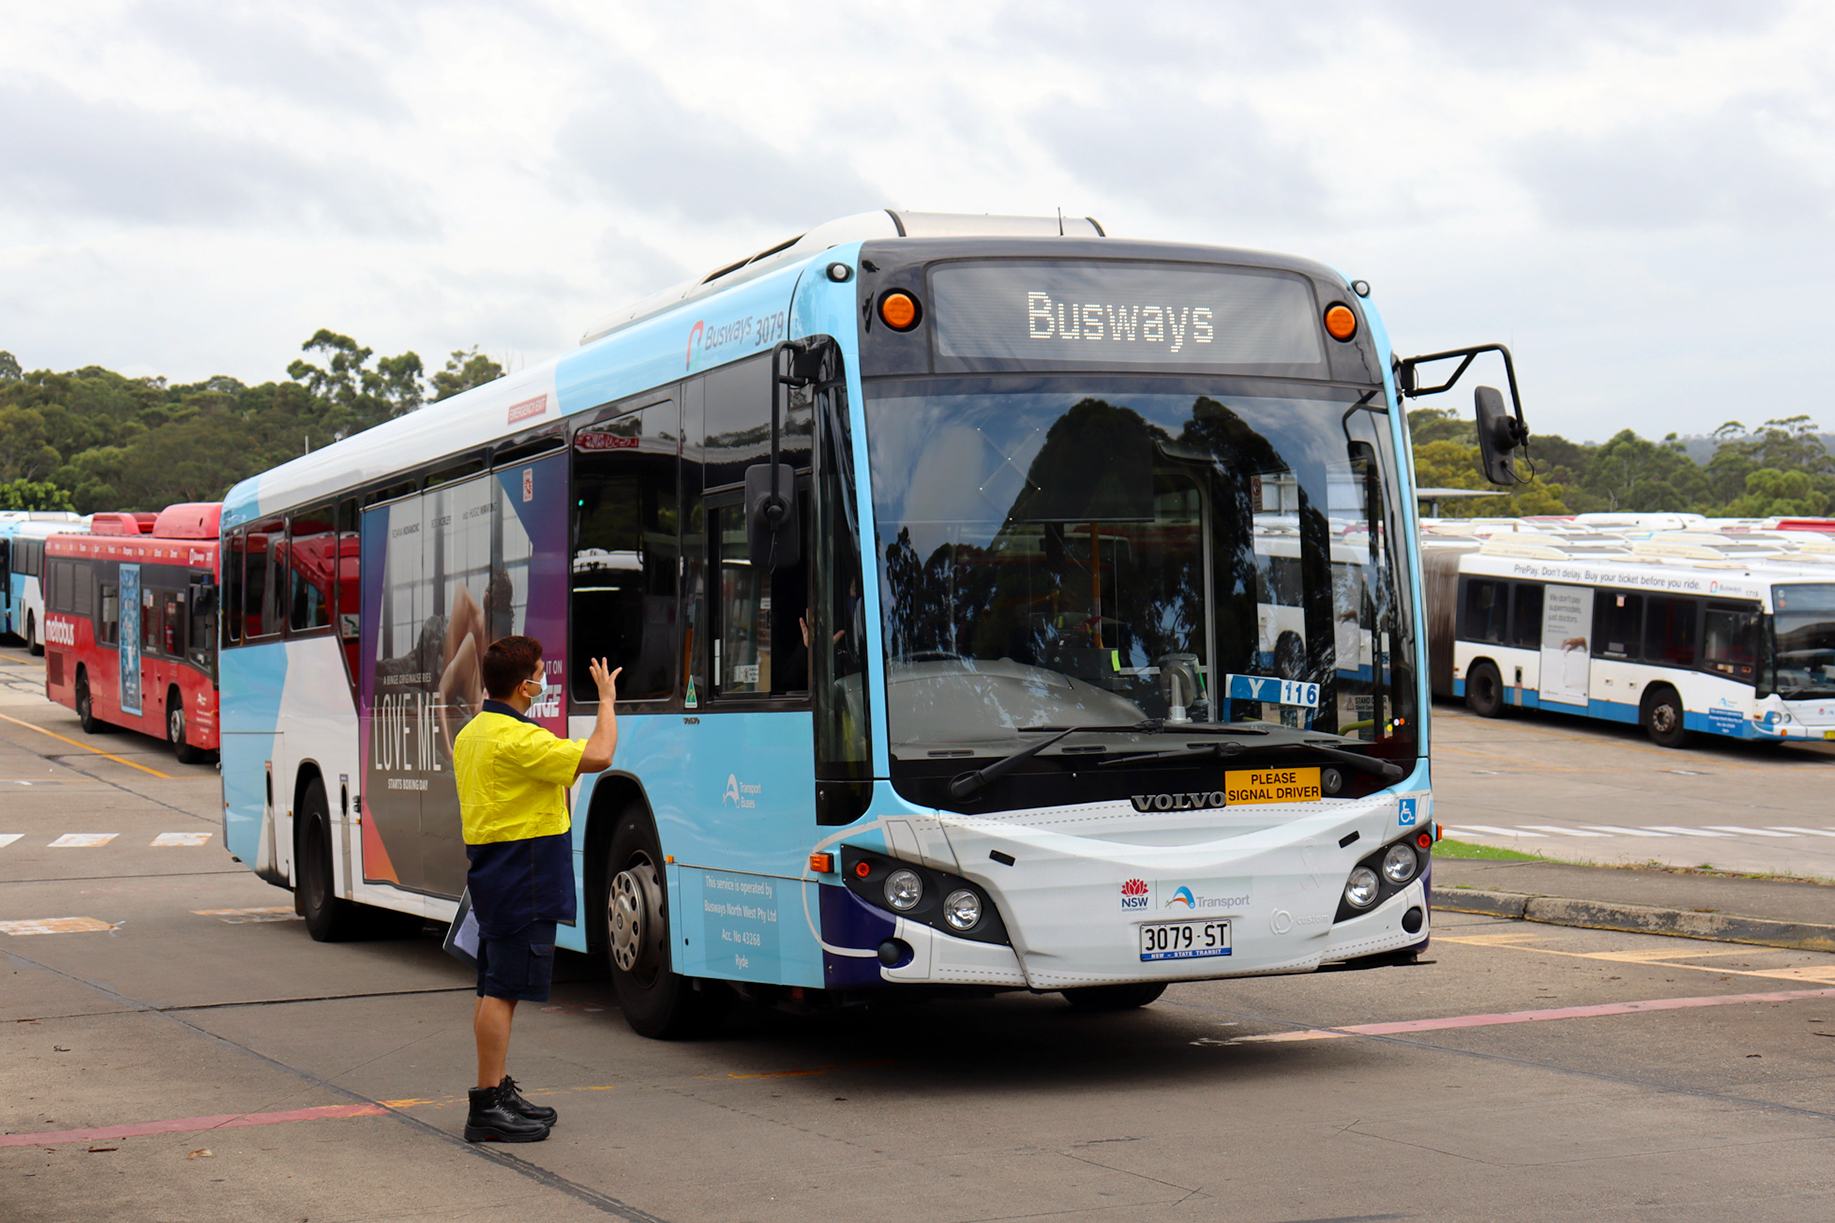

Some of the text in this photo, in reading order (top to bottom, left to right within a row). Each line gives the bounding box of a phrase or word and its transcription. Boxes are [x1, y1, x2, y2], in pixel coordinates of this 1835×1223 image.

[705, 311, 784, 351] Busways 3079
[1028, 291, 1213, 353] Busways
[510, 397, 546, 421] EMERGENCY EXIT
[1514, 564, 1702, 590] PrePay. Don't delay. Buy your ticket before you ride.
[46, 615, 75, 646] metrobus
[553, 660, 563, 675] ON
[1247, 678, 1317, 705] Y 116
[374, 692, 441, 771] LOVE ME
[388, 778, 402, 789] STARTS
[419, 779, 428, 791] DAY
[1251, 772, 1296, 785] PLEASE
[739, 782, 761, 796] Transport
[1229, 786, 1319, 801] SIGNAL DRIVER
[741, 797, 756, 809] Buses
[1131, 791, 1226, 811] VOLVO
[705, 875, 773, 899] This service is operated by
[1121, 897, 1149, 908] NSW
[1197, 894, 1250, 909] Transport
[704, 899, 777, 924] Busways North West Pty Ltd
[1296, 913, 1329, 926] custom
[722, 928, 761, 947] Acc. No 43268
[1145, 923, 1228, 951] 3079 ST
[735, 953, 749, 970] Ryde
[1195, 948, 1222, 957] TRANSIT
